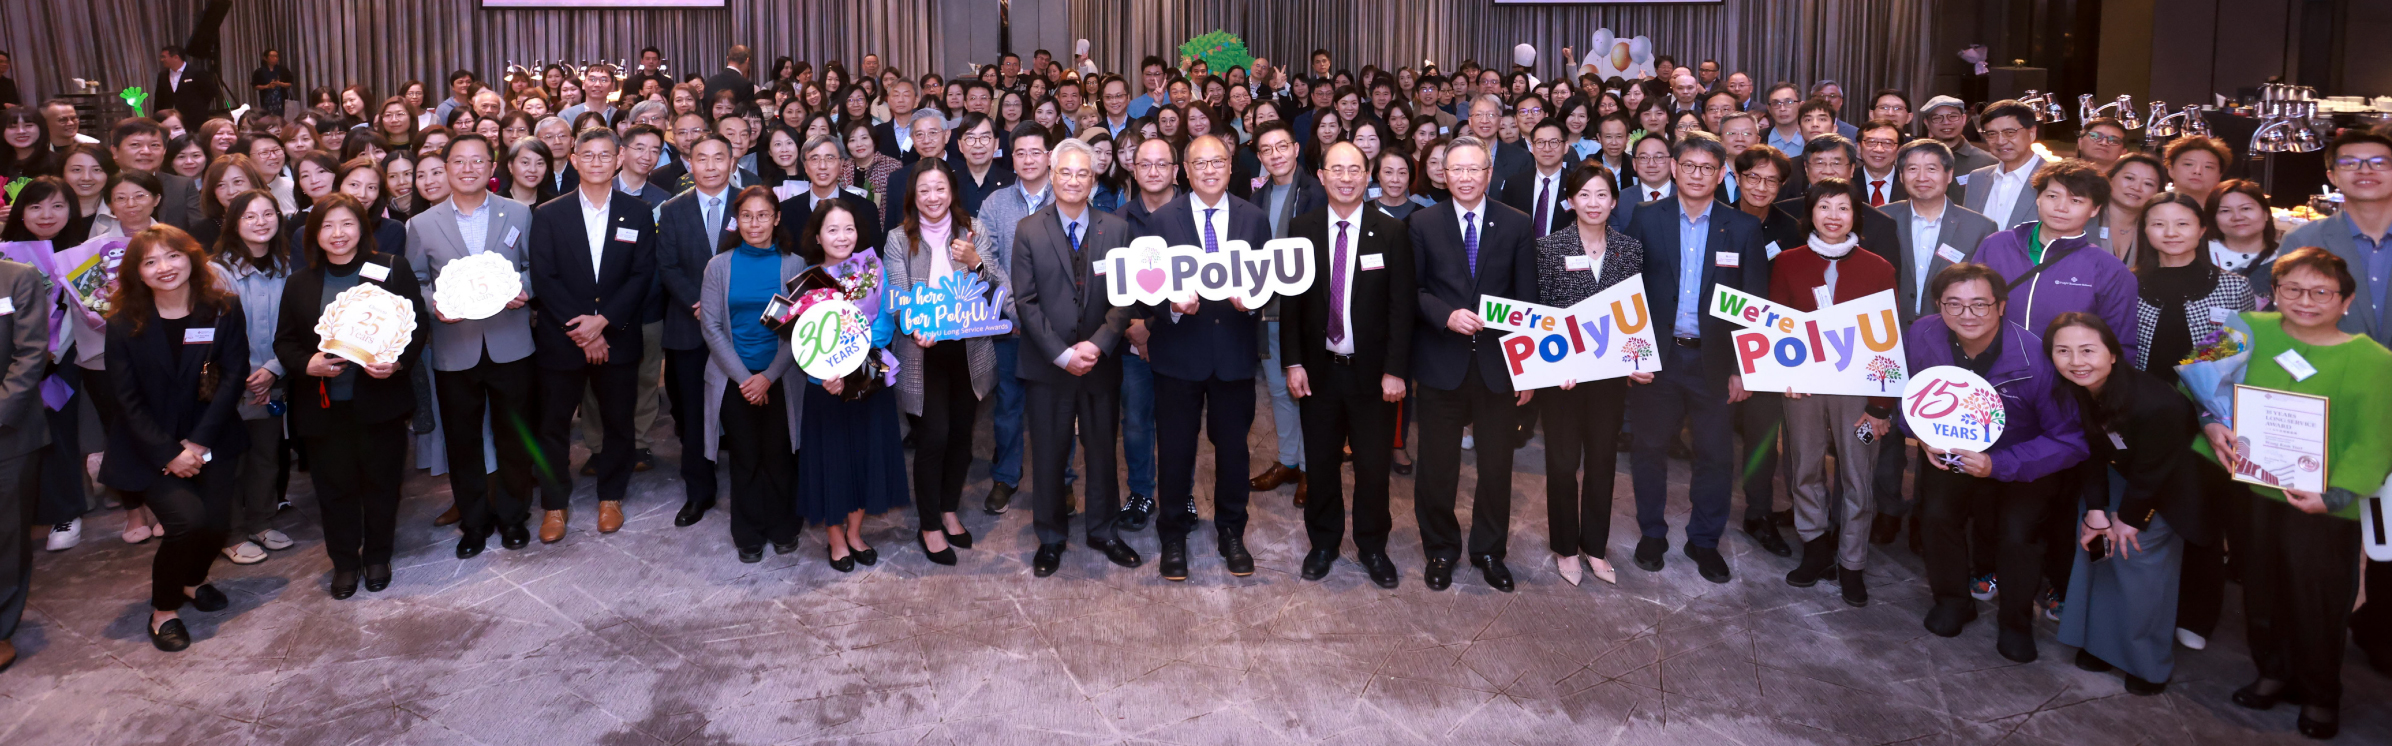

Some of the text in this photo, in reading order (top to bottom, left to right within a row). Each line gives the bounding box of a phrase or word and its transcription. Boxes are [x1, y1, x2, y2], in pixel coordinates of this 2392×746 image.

[1115, 248, 1305, 298] I PolyU
[889, 286, 945, 310] I'm here
[357, 311, 386, 336] 25
[905, 308, 931, 330] for
[1486, 301, 1556, 331] We're
[1720, 290, 1795, 334] We're
[349, 326, 374, 344] Years
[797, 311, 841, 370] 30
[943, 328, 960, 336] Long
[961, 326, 983, 334] Service
[985, 323, 1008, 331] Awards
[1503, 293, 1648, 376] PolyU
[1736, 309, 1899, 375] PolyU
[825, 342, 860, 368] YEARS
[1907, 378, 1969, 420] 15
[2265, 415, 2317, 428] LONG SERVICE
[2265, 421, 2292, 430] AWARD
[2273, 410, 2297, 419] YEARS
[1932, 422, 1978, 441] YEARS
